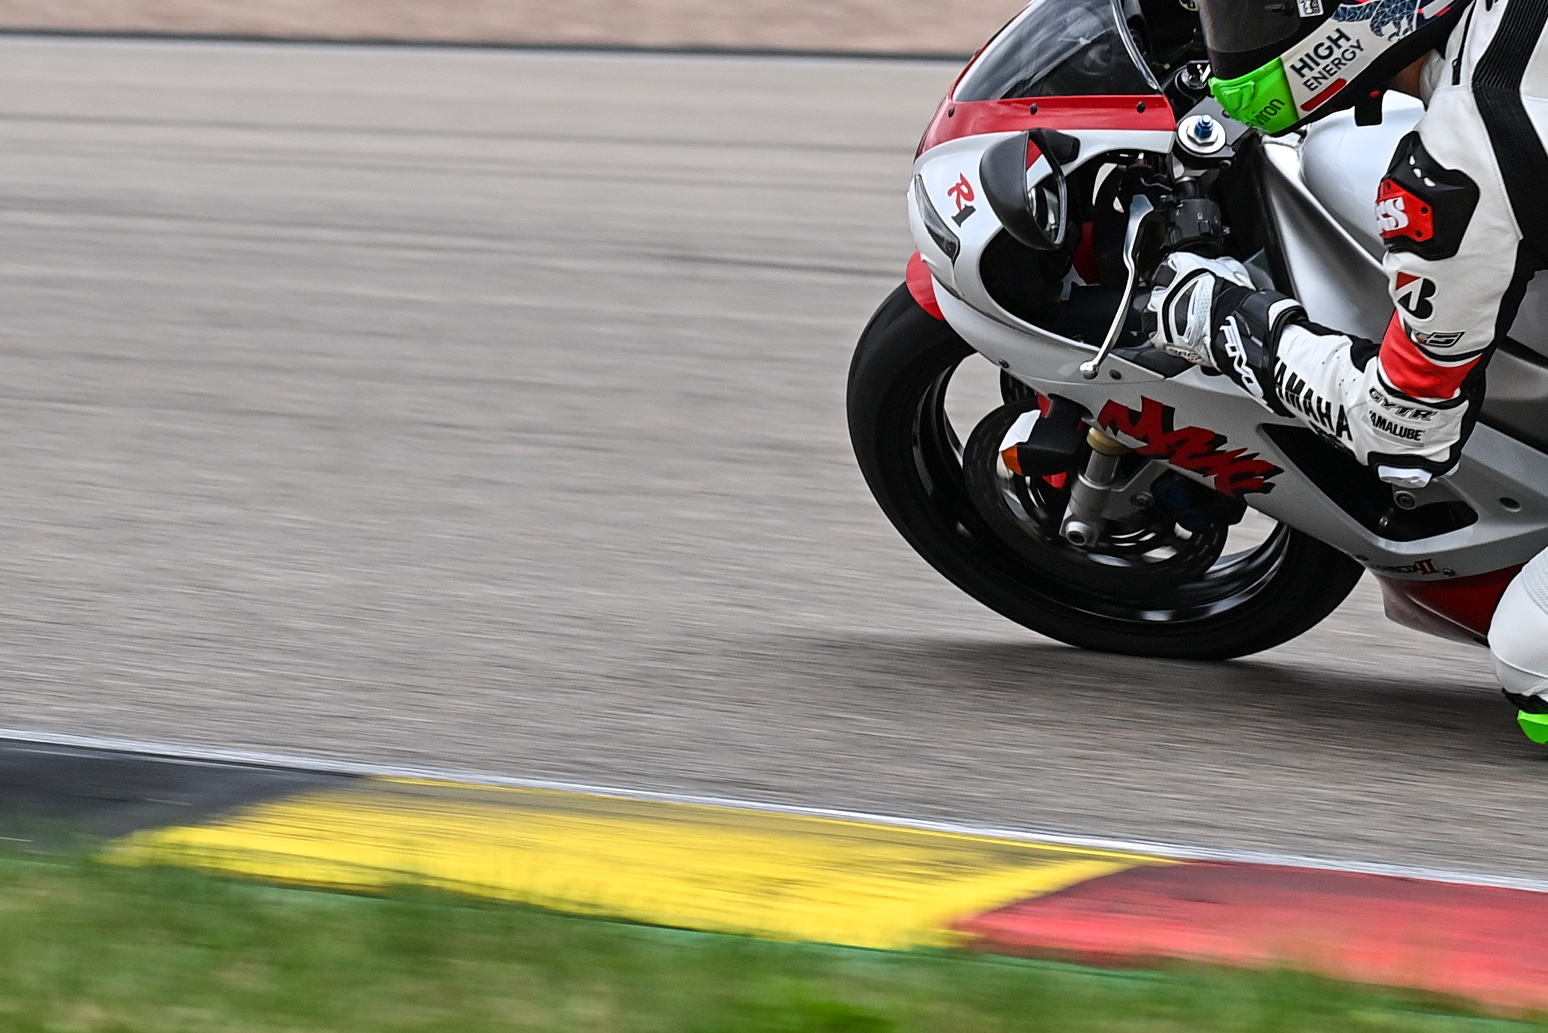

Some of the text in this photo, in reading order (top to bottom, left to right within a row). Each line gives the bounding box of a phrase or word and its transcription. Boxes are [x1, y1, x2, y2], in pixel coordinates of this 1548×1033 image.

[1289, 27, 1352, 79] HIGH
[1302, 38, 1365, 92] ENERGY
[947, 172, 977, 228] R1
[1275, 356, 1354, 443] AMAHA
[1369, 387, 1438, 422] GYTR
[1369, 410, 1425, 441] AMALUBE
